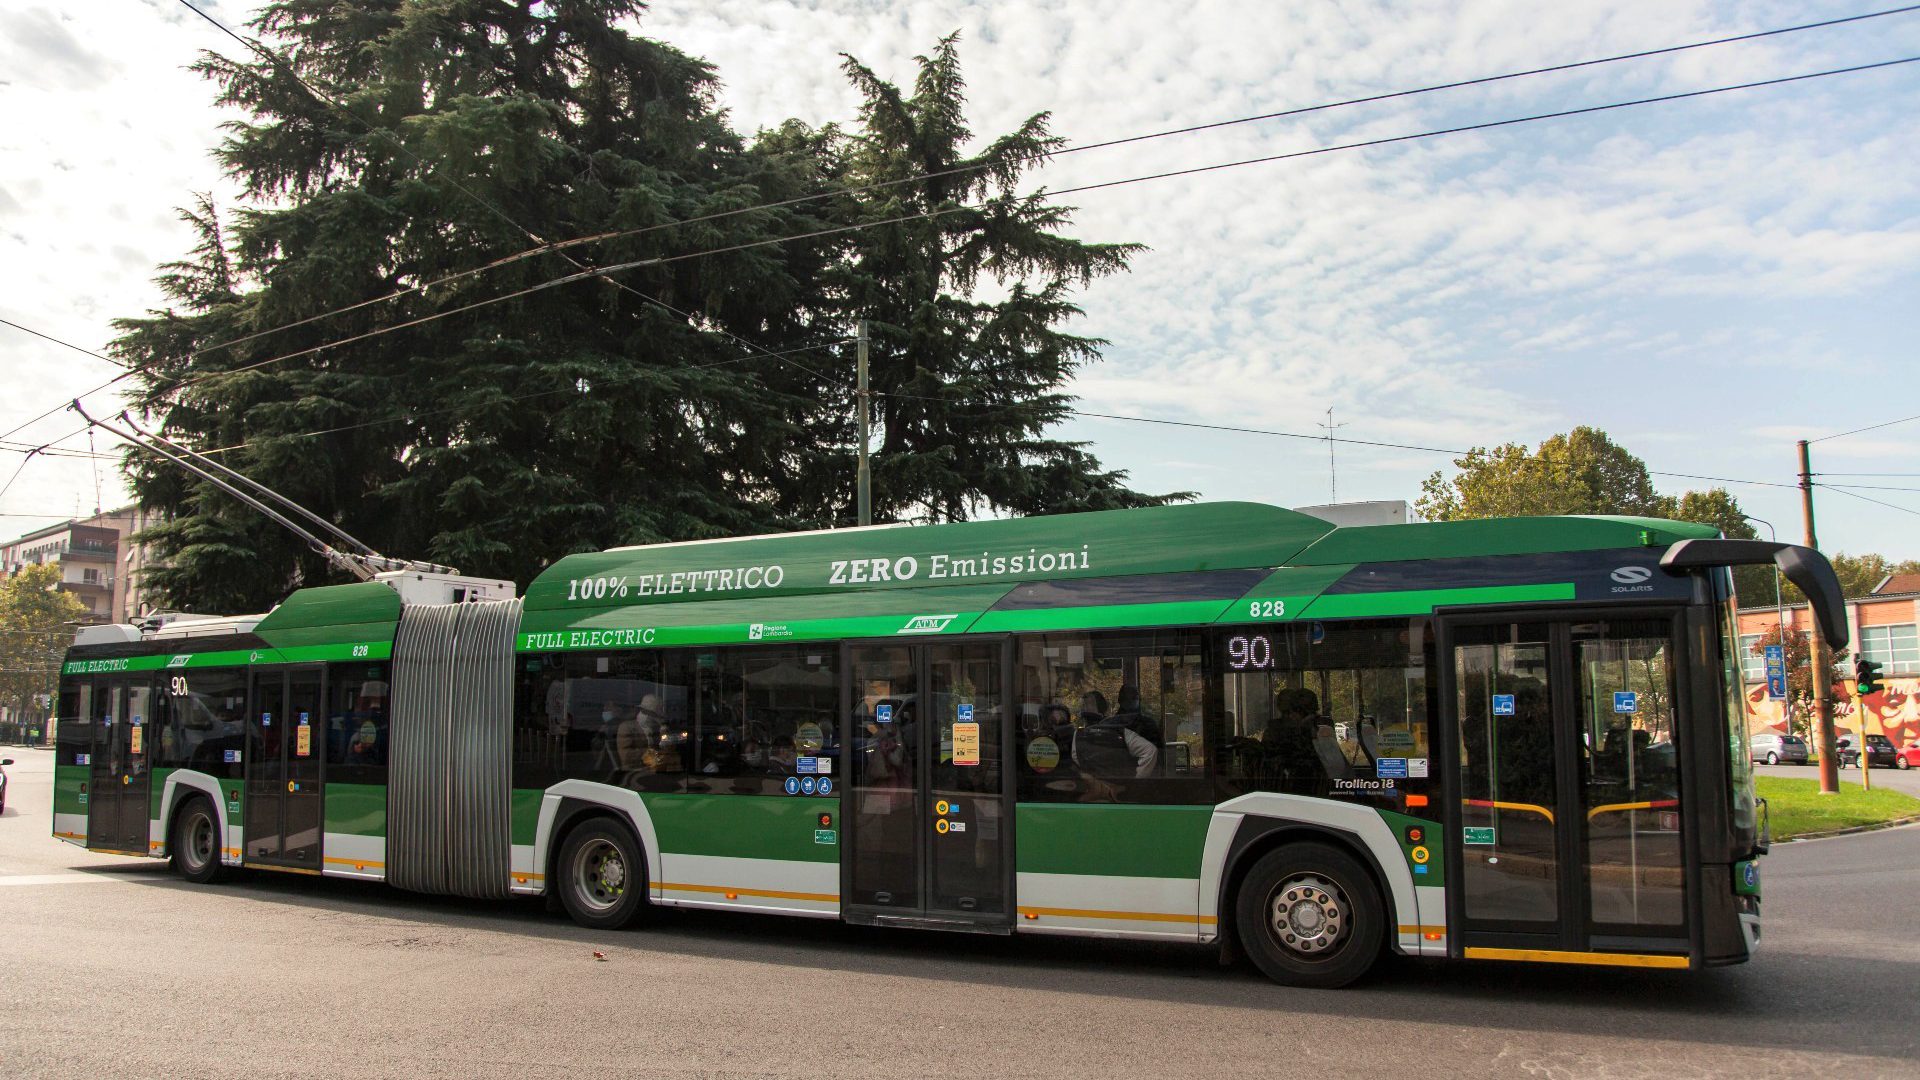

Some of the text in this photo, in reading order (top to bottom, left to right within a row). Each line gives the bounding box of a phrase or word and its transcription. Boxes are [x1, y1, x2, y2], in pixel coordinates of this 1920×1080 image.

[829, 544, 1090, 585] ZERO Emissioni
[568, 565, 784, 601] 100% ELETTRICO
[1611, 585, 1654, 593] SOLARIS
[1249, 600, 1285, 618] 828
[914, 619, 939, 629] ATM
[526, 628, 656, 649] FULL ELECTRIC
[352, 645, 369, 657] 828
[67, 658, 129, 673] FULL ELECTRIC
[1333, 778, 1395, 789] Trollino 18
